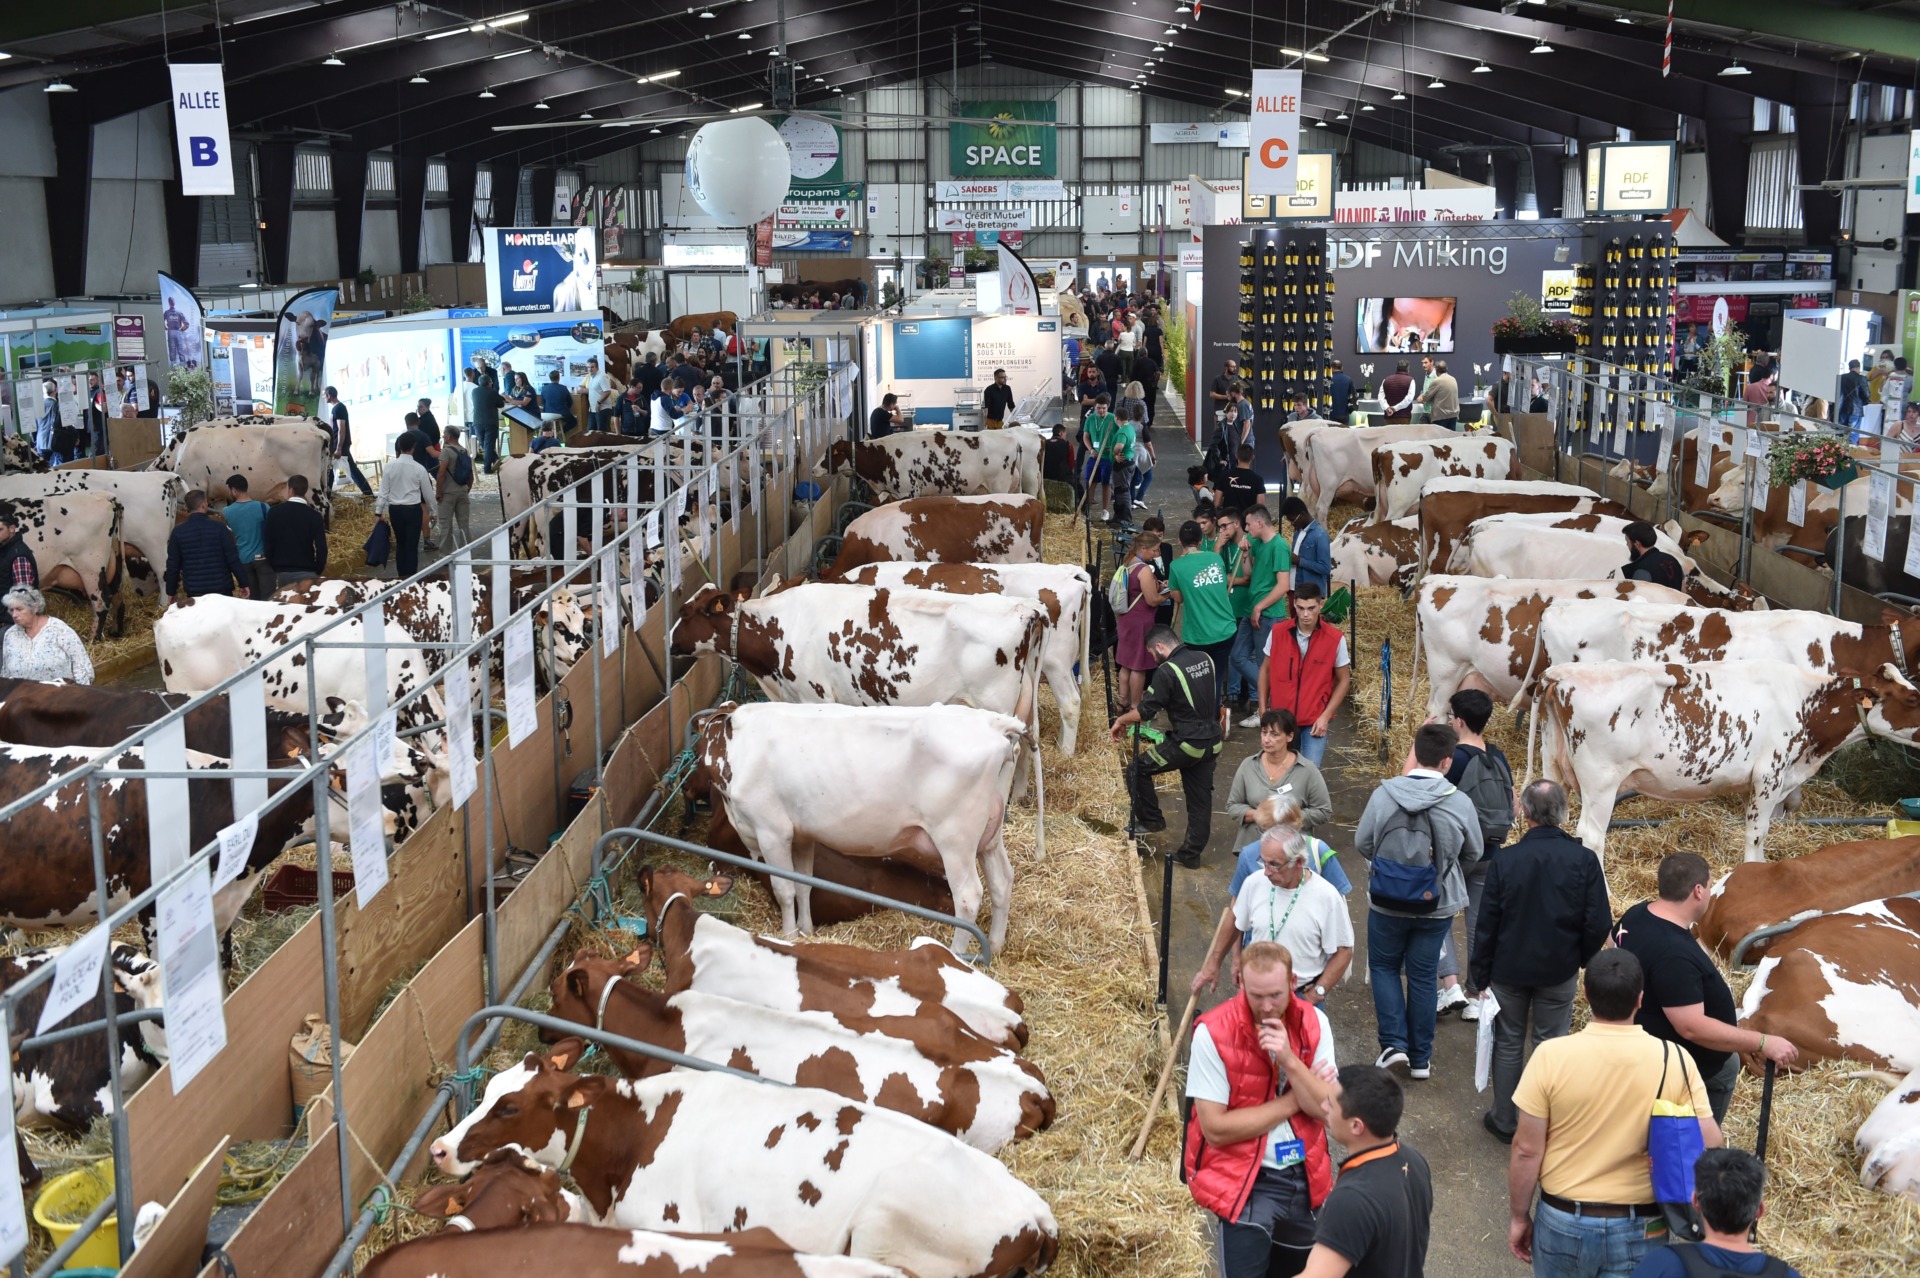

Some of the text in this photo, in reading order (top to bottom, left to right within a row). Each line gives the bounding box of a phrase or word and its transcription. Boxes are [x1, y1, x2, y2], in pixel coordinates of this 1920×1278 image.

[180, 91, 220, 109] ALLÉE
[1256, 95, 1296, 112] ALLÉE
[190, 136, 219, 167] B
[966, 145, 1042, 166] SPACE
[1260, 138, 1289, 169] C
[1623, 172, 1649, 184] ADF
[786, 187, 840, 199] roupama
[961, 185, 998, 193] SANDERS
[1121, 203, 1129, 211] C
[1290, 196, 1316, 207] milking
[559, 204, 567, 212] A
[869, 205, 876, 213] B
[964, 210, 1025, 220] Crédit Mutuel
[964, 220, 1018, 230] de Bretagne
[1392, 235, 1508, 275] Milking
[1548, 286, 1570, 296] ADF
[504, 304, 551, 312] www.umotest.com
[1193, 573, 1224, 588] SPACE
[1185, 660, 1210, 674] DEUTZ
[1190, 667, 1211, 679] FAHR
[1282, 1152, 1300, 1163] SPACE
